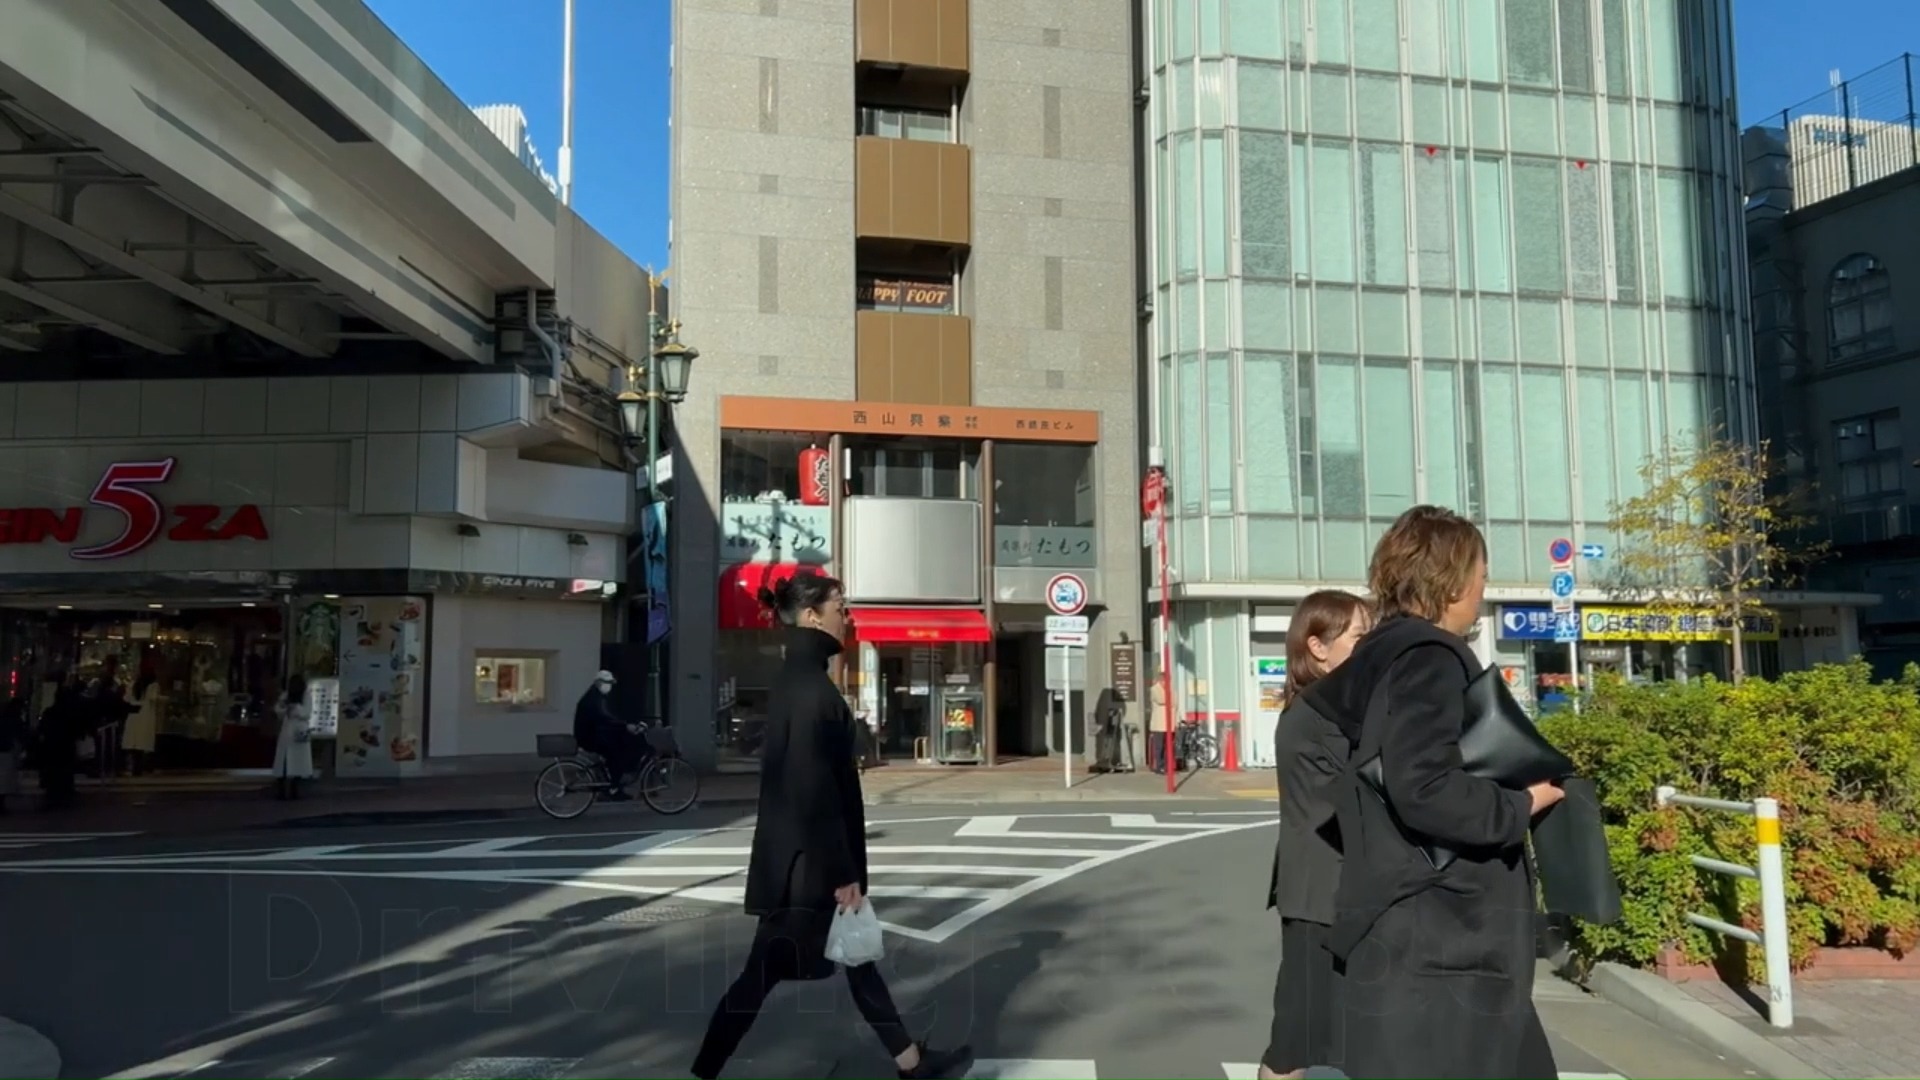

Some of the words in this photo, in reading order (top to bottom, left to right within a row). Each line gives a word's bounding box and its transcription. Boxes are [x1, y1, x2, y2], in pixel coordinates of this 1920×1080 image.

[906, 289, 949, 305] FOOT
[1036, 537, 1091, 556] たもつ
[525, 578, 556, 589] FIVE
